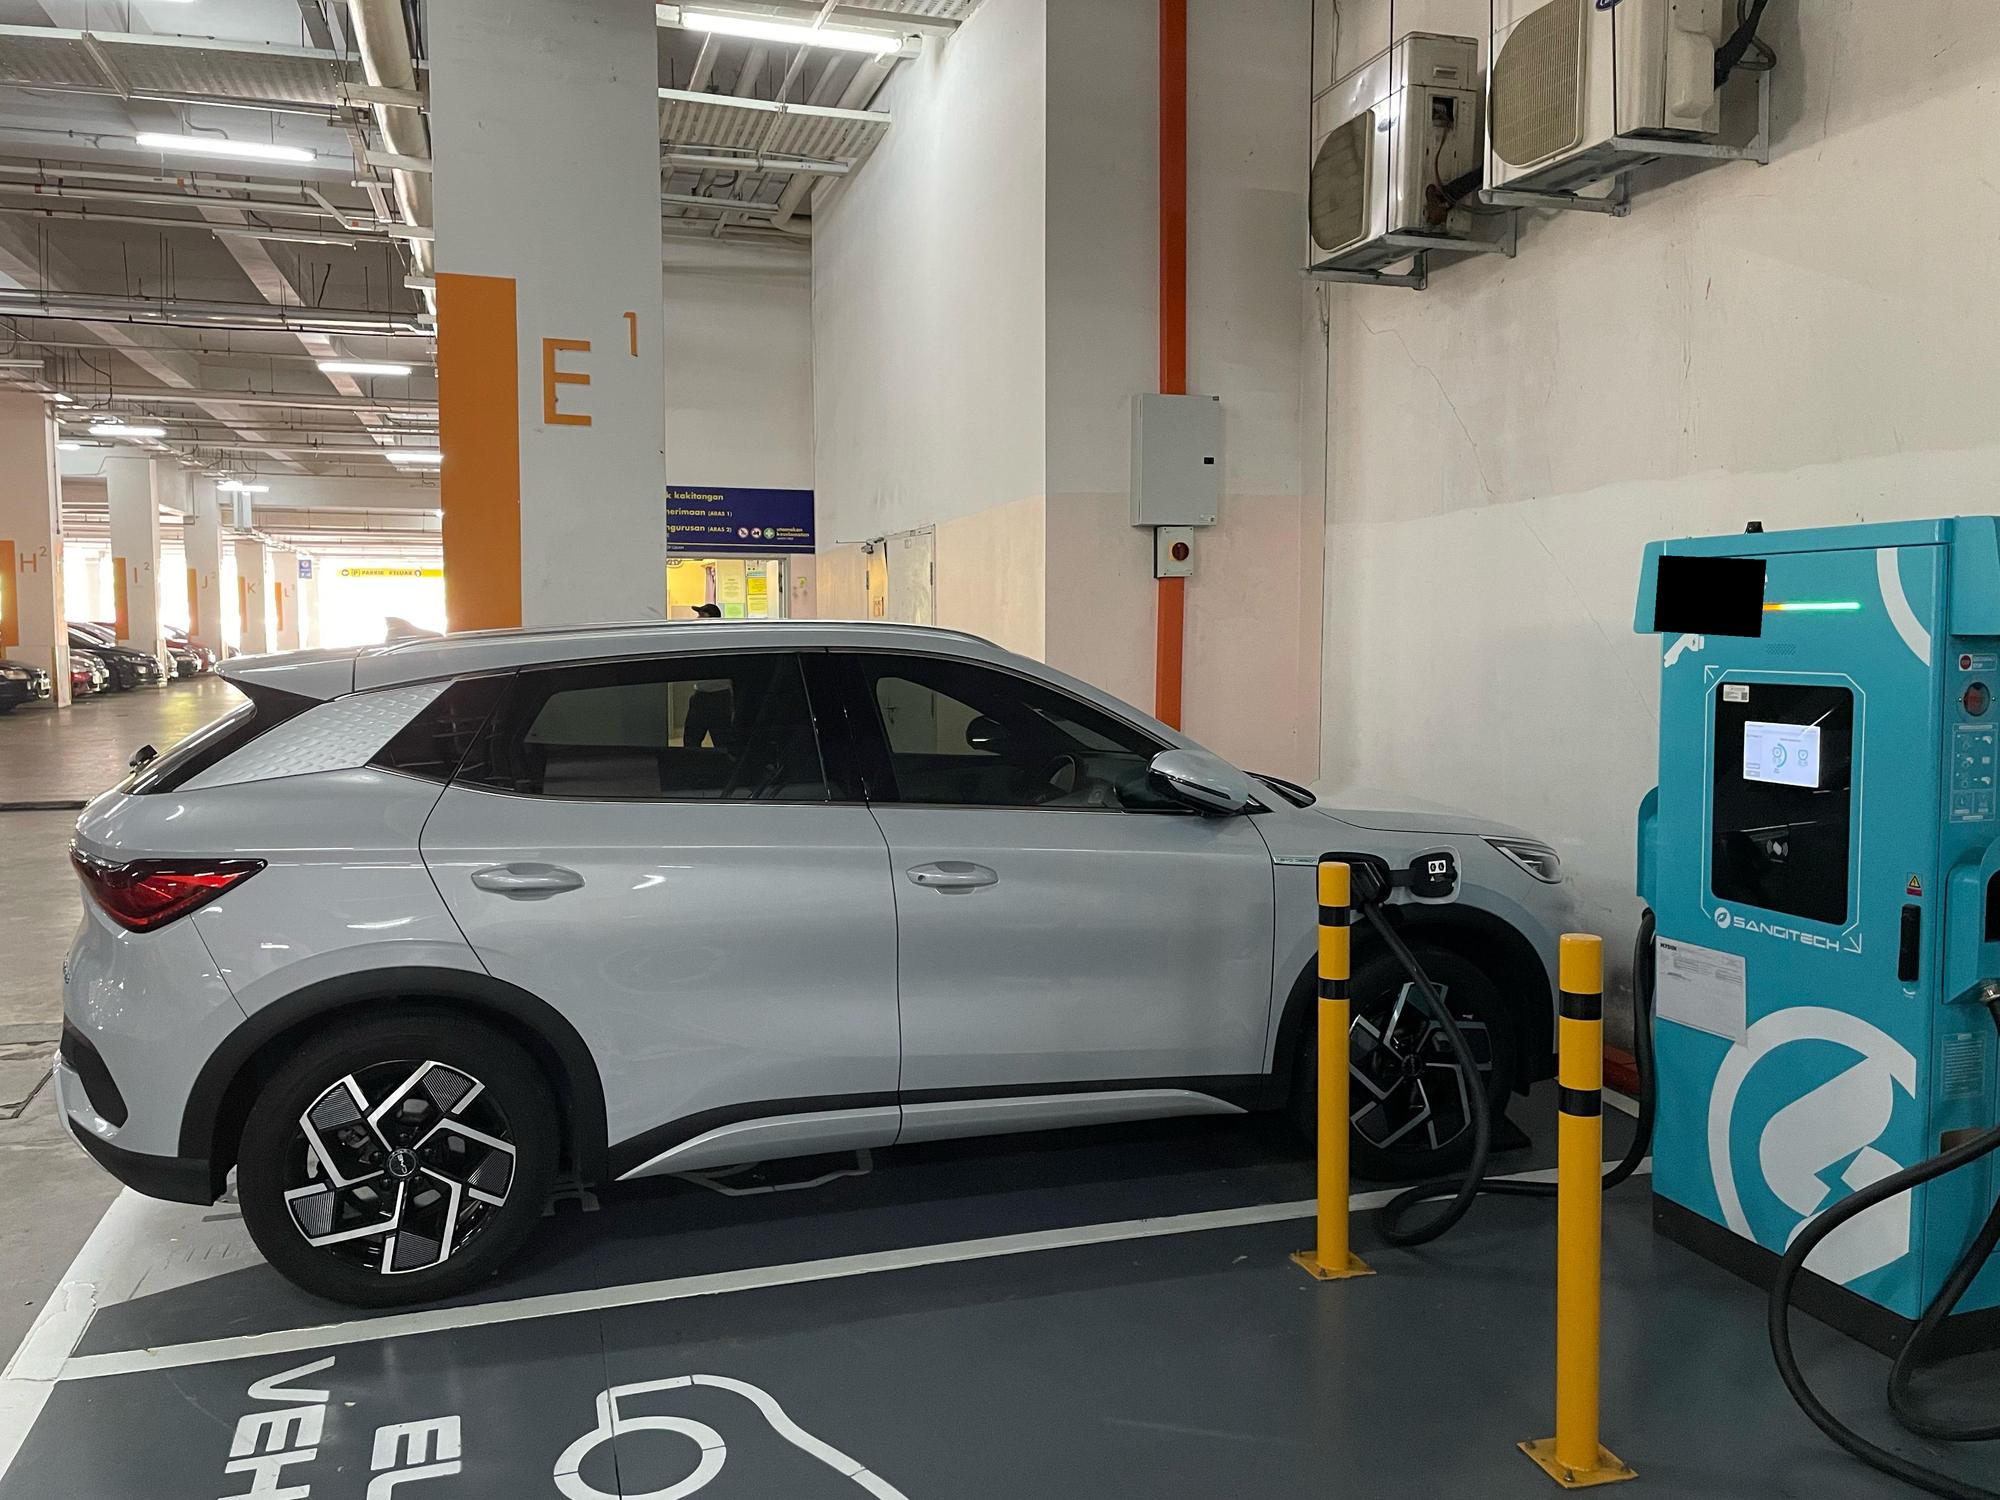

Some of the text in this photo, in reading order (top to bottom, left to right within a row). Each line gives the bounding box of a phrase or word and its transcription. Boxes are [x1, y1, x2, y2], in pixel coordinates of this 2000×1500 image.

[543, 312, 638, 427] E 1
[674, 491, 724, 502] kakitangan
[20, 546, 48, 573] H 2
[201, 576, 208, 589] J
[247, 582, 256, 594] K
[1733, 916, 1840, 952] SANGITECH
